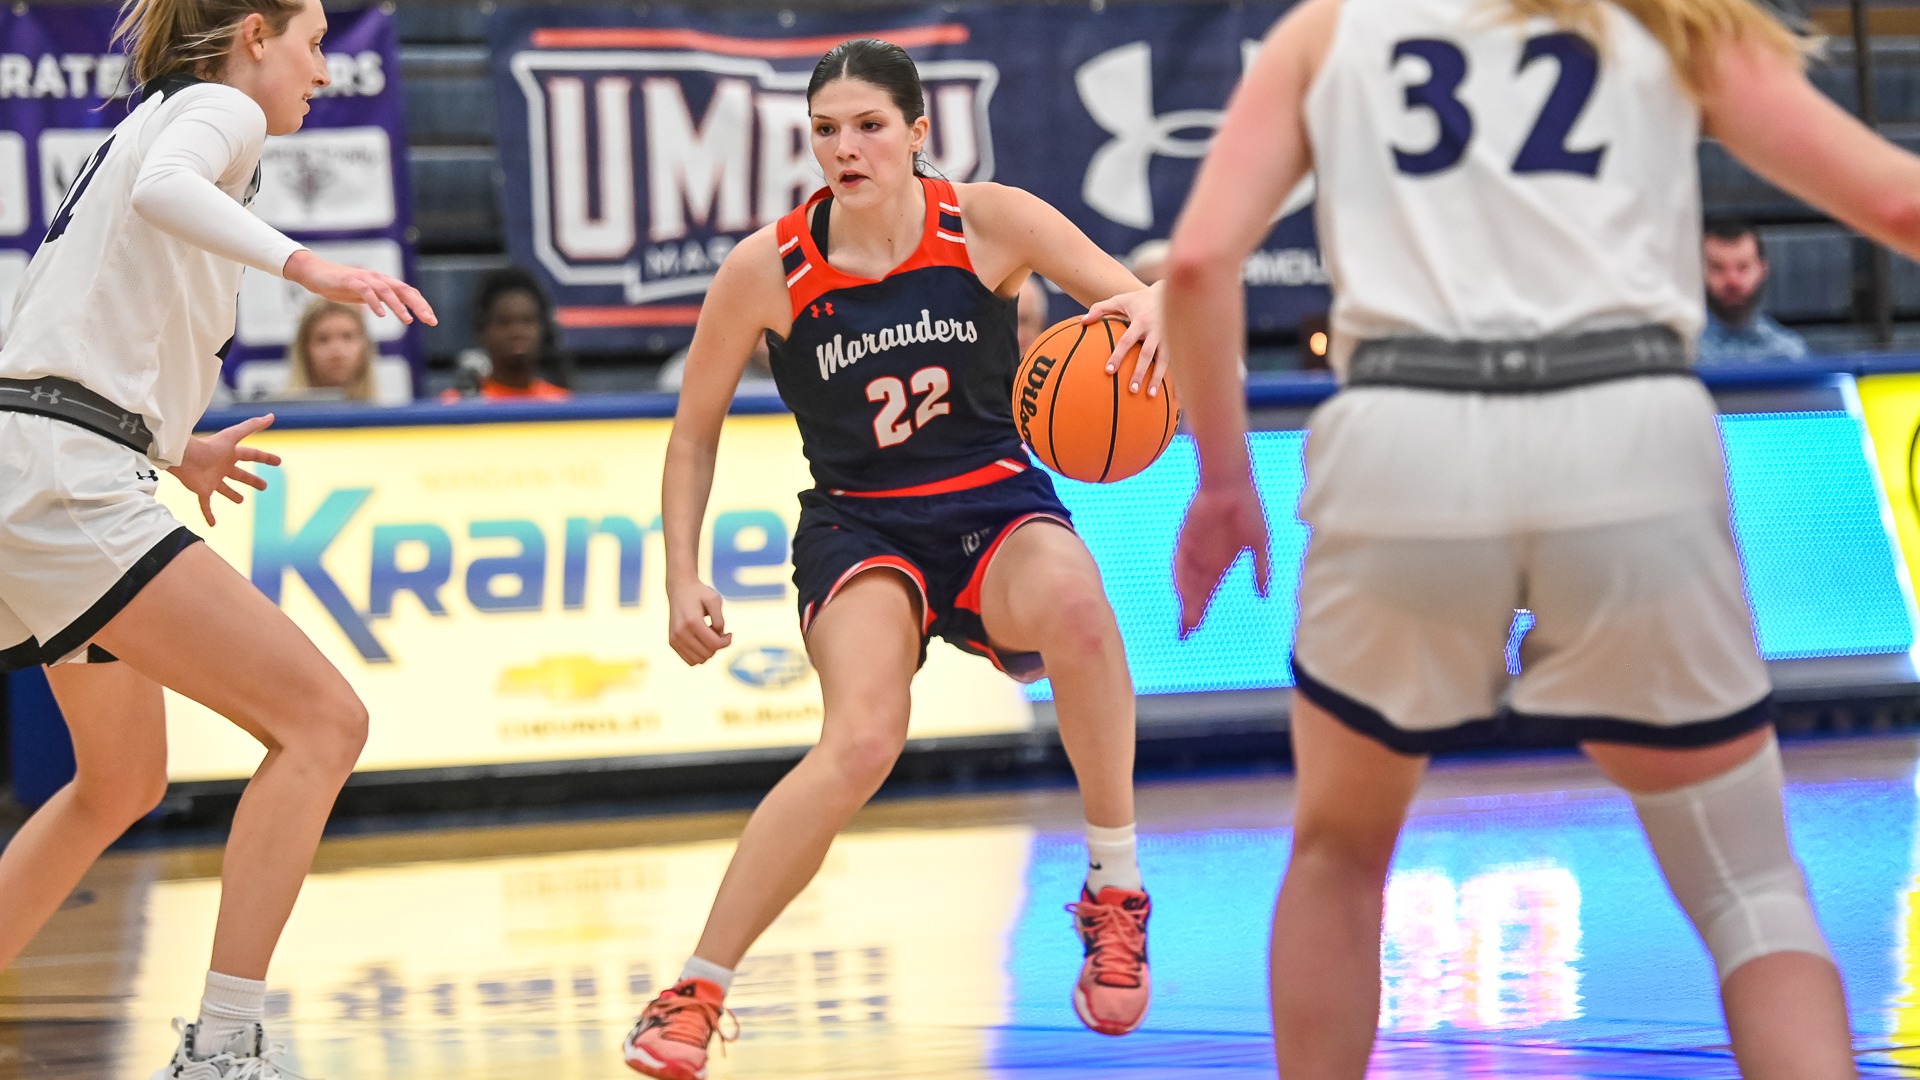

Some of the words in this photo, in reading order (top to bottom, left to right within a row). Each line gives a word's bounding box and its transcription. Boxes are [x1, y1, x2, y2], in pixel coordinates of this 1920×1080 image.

[1389, 32, 1608, 178] 32
[816, 309, 978, 381] Marauders
[865, 365, 951, 449] 22
